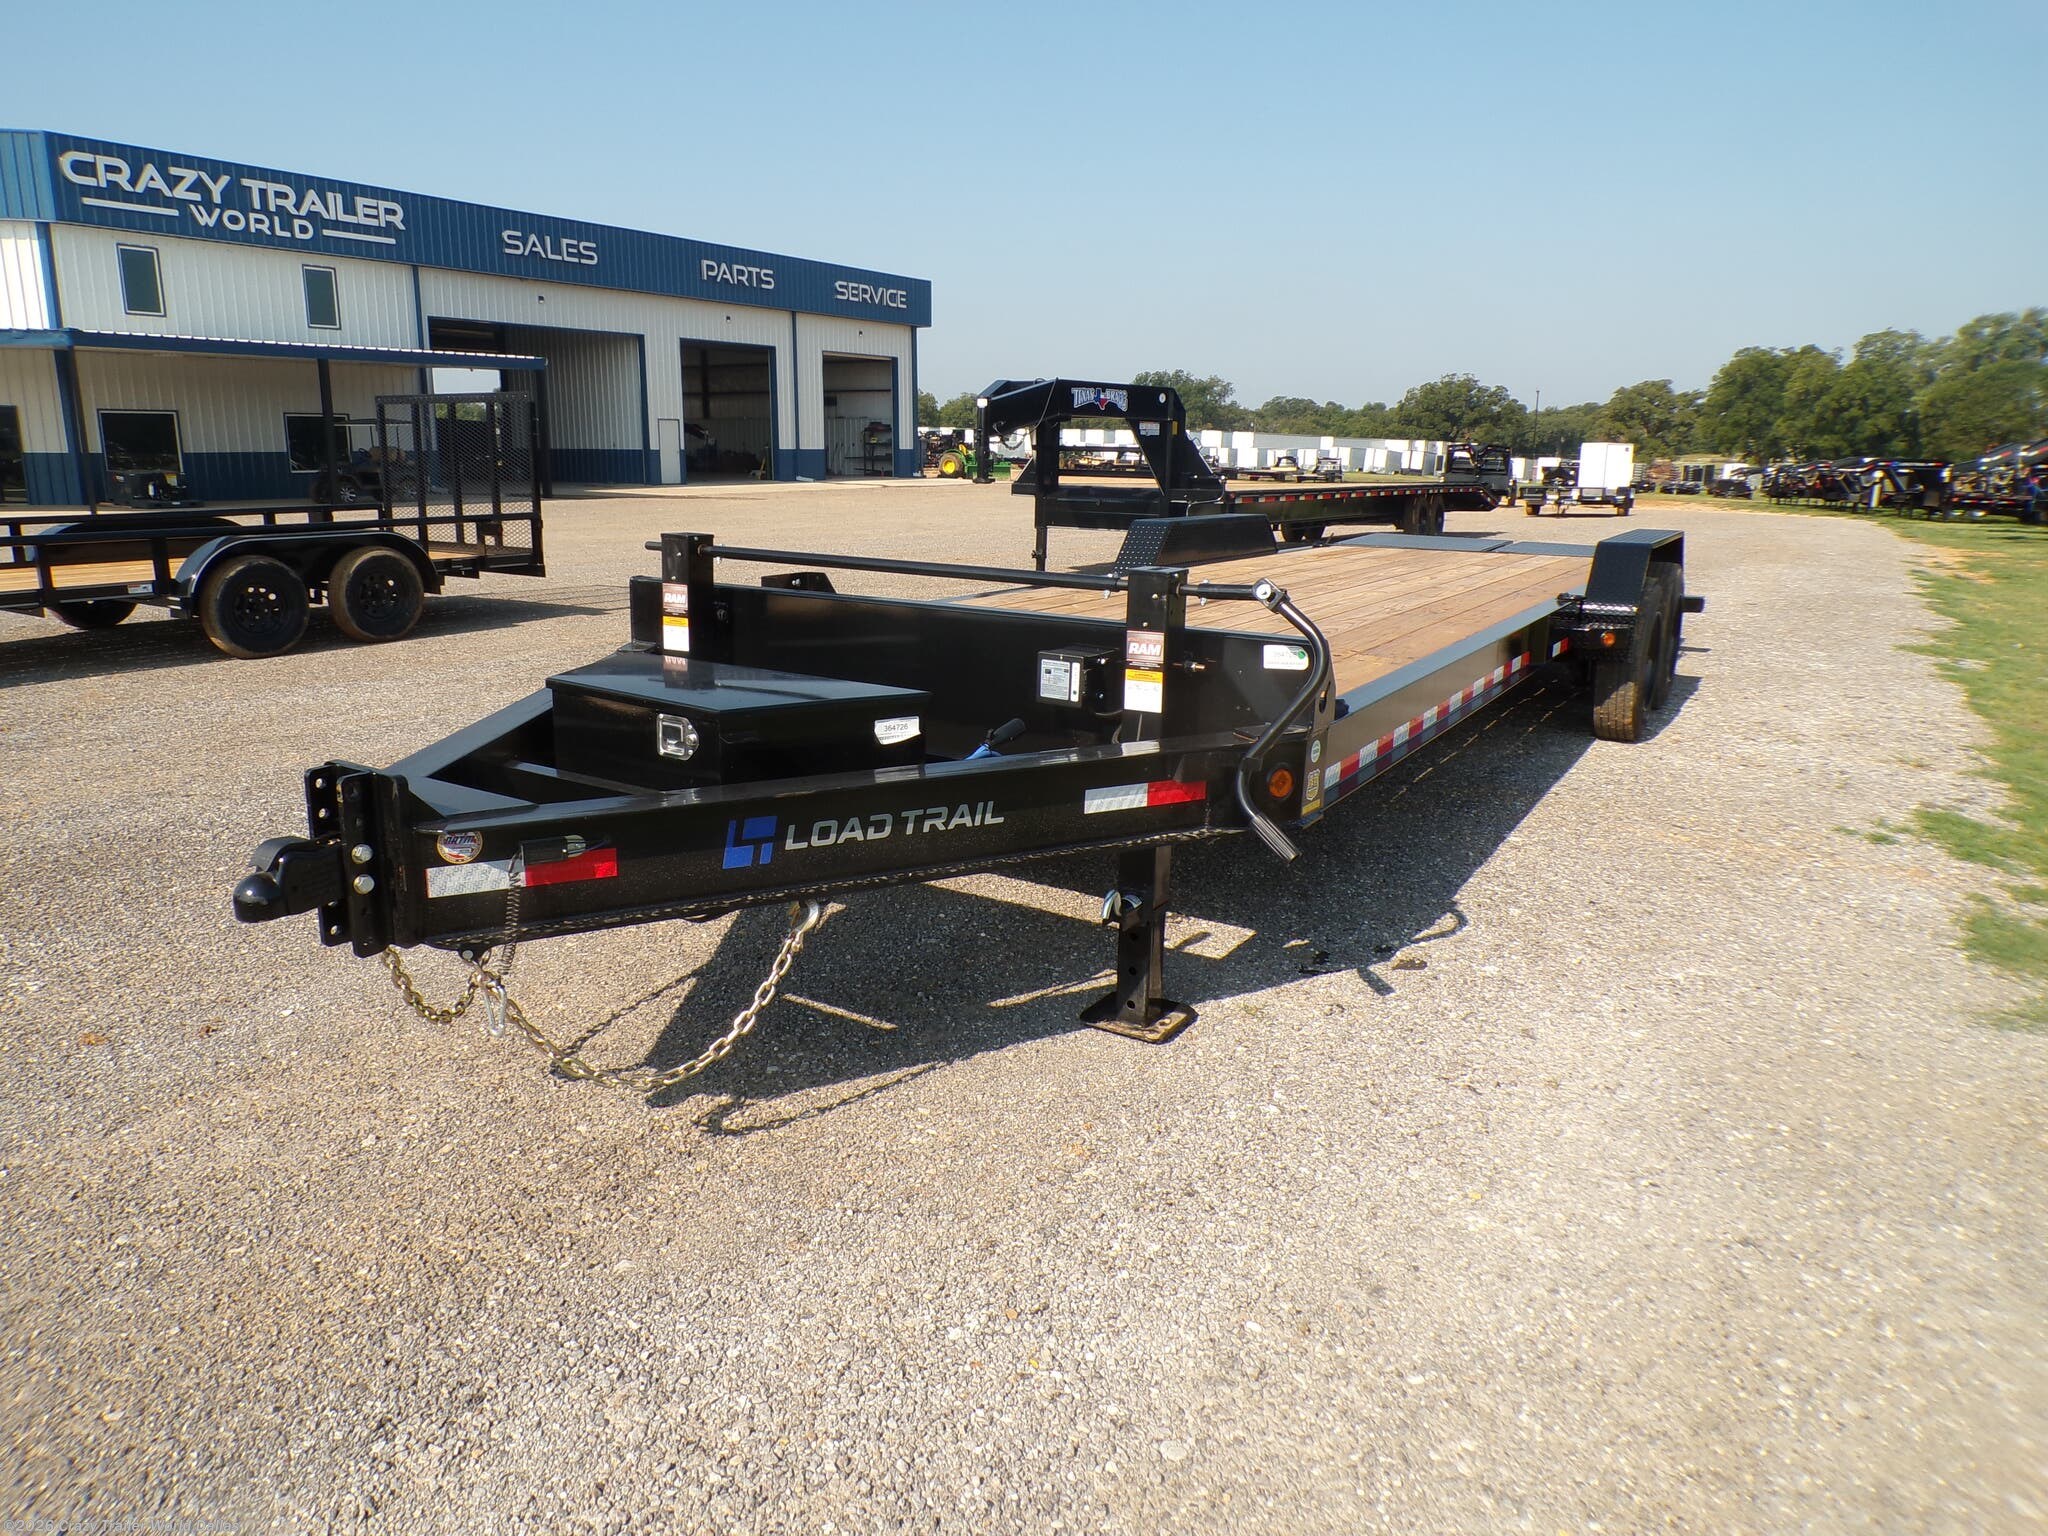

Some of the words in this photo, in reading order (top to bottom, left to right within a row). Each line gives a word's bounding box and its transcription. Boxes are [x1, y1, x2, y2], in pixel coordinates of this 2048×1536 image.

[59, 150, 231, 204] CRAZY
[241, 178, 406, 231] TRAILER
[189, 204, 314, 240] WORLD
[502, 230, 598, 266] SALES
[701, 259, 775, 290] PARTS
[834, 280, 908, 309] SERVICE
[664, 592, 686, 604] RAM
[1128, 641, 1162, 657] RAM
[785, 813, 893, 850] LOAD
[901, 800, 1005, 835] TRAIL
